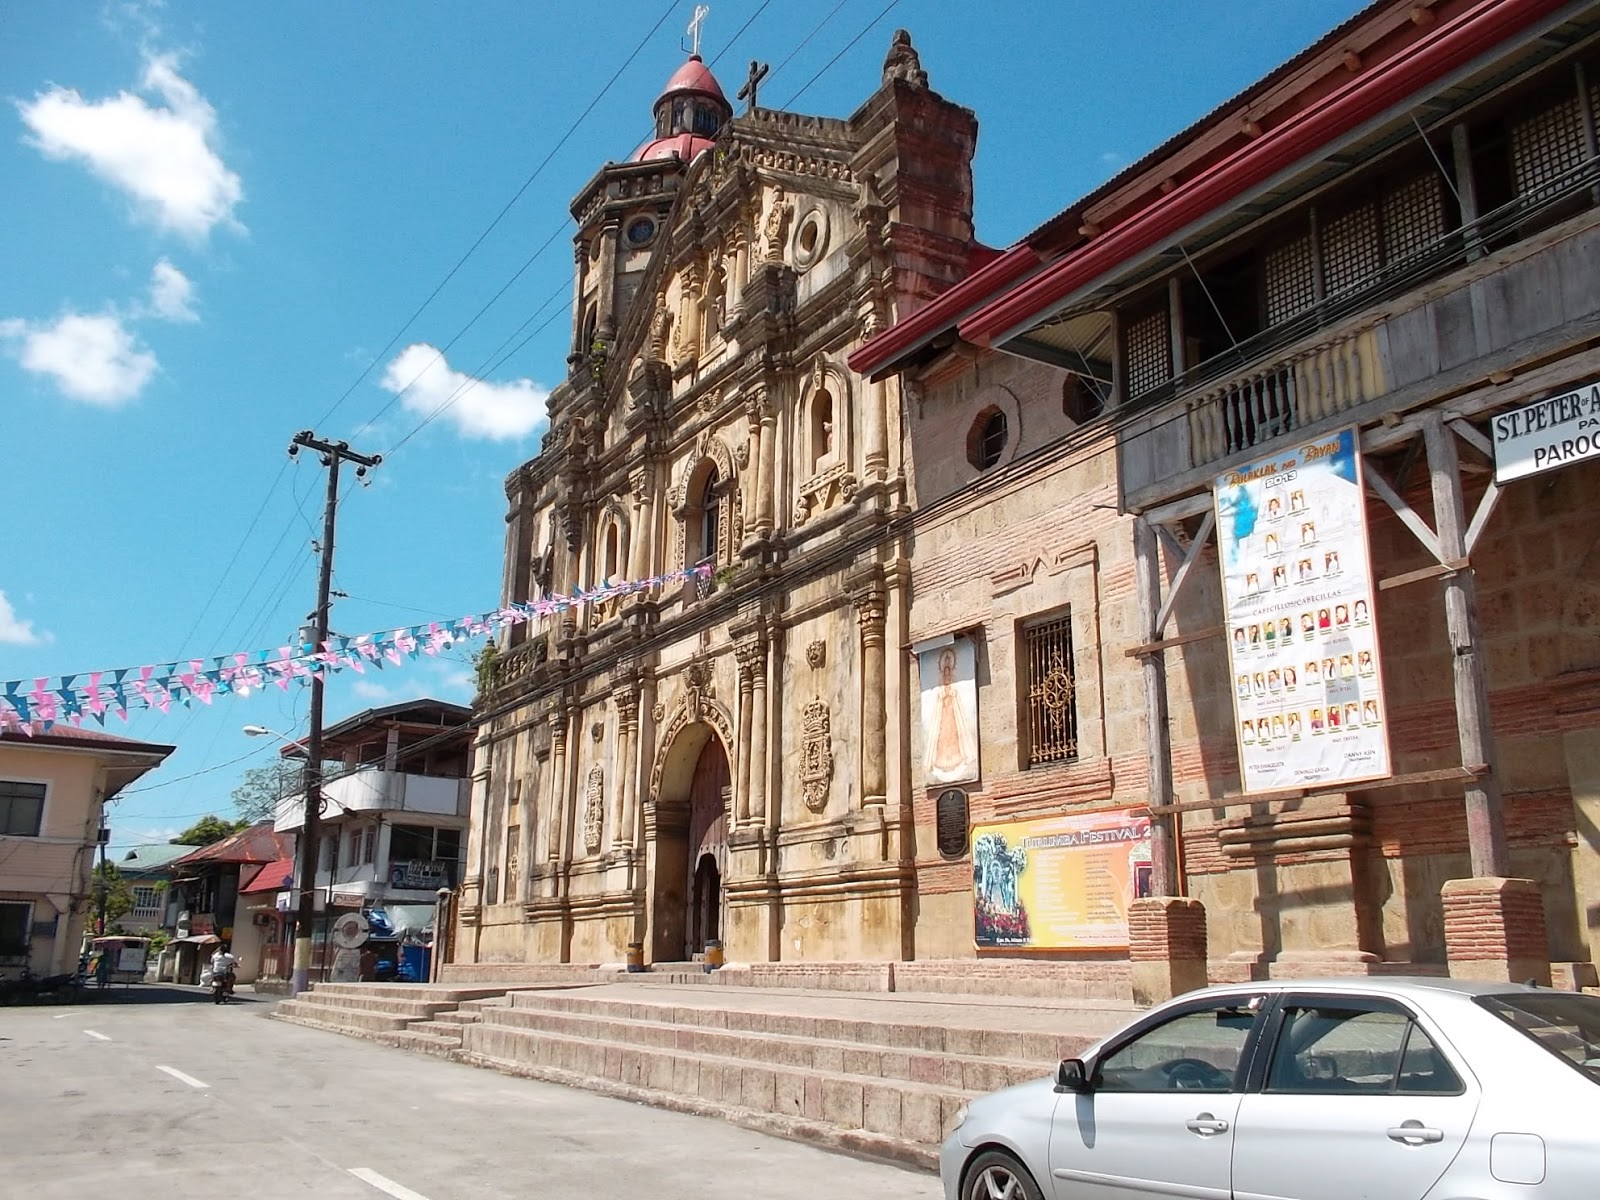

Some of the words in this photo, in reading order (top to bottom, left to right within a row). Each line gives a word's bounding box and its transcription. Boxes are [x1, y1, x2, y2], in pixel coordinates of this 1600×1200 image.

[1298, 441, 1340, 465] BAYAN
[1265, 470, 1298, 488] 2013
[1080, 827, 1141, 844] FESTIVAL
